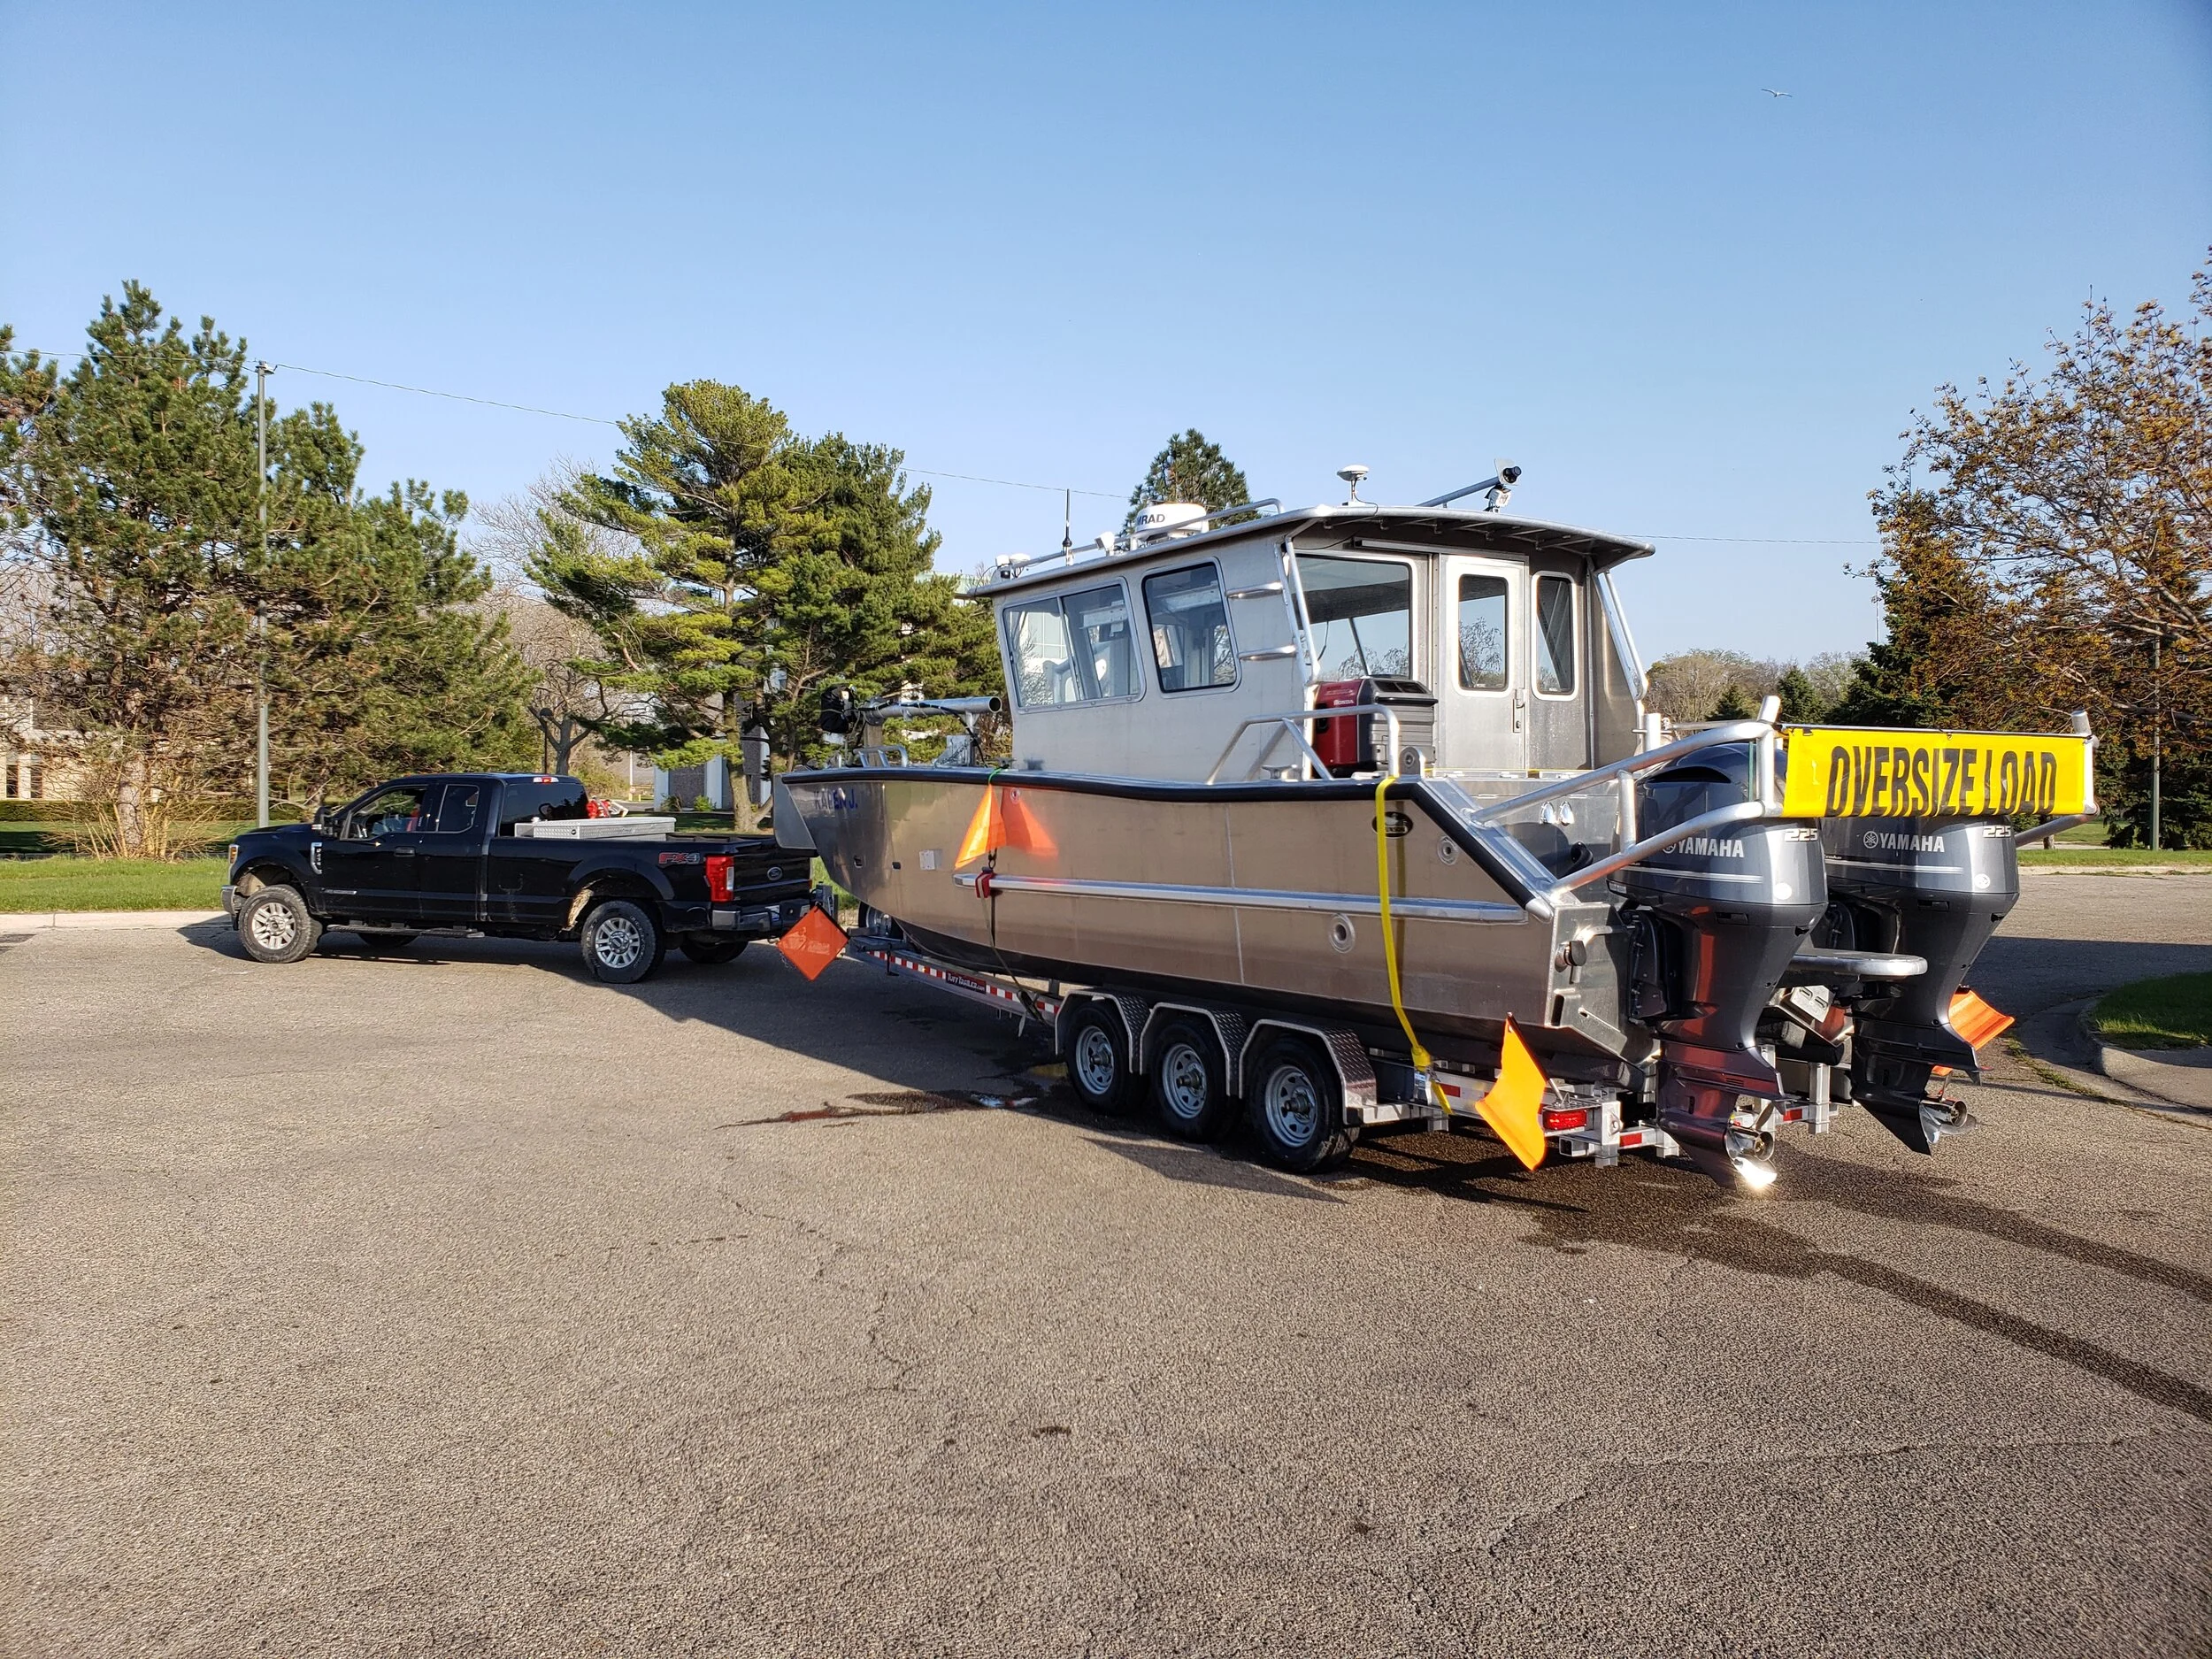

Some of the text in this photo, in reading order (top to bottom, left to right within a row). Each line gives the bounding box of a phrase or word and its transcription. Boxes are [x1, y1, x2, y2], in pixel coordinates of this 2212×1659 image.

[1824, 746, 2057, 817] OVERSIZE LOAD
[1784, 828, 1818, 842] 225
[1983, 825, 2011, 839] 225
[1678, 837, 1745, 858] YAMAHA
[1879, 833, 1946, 853] YAMAHA
[658, 852, 700, 864] FX4
